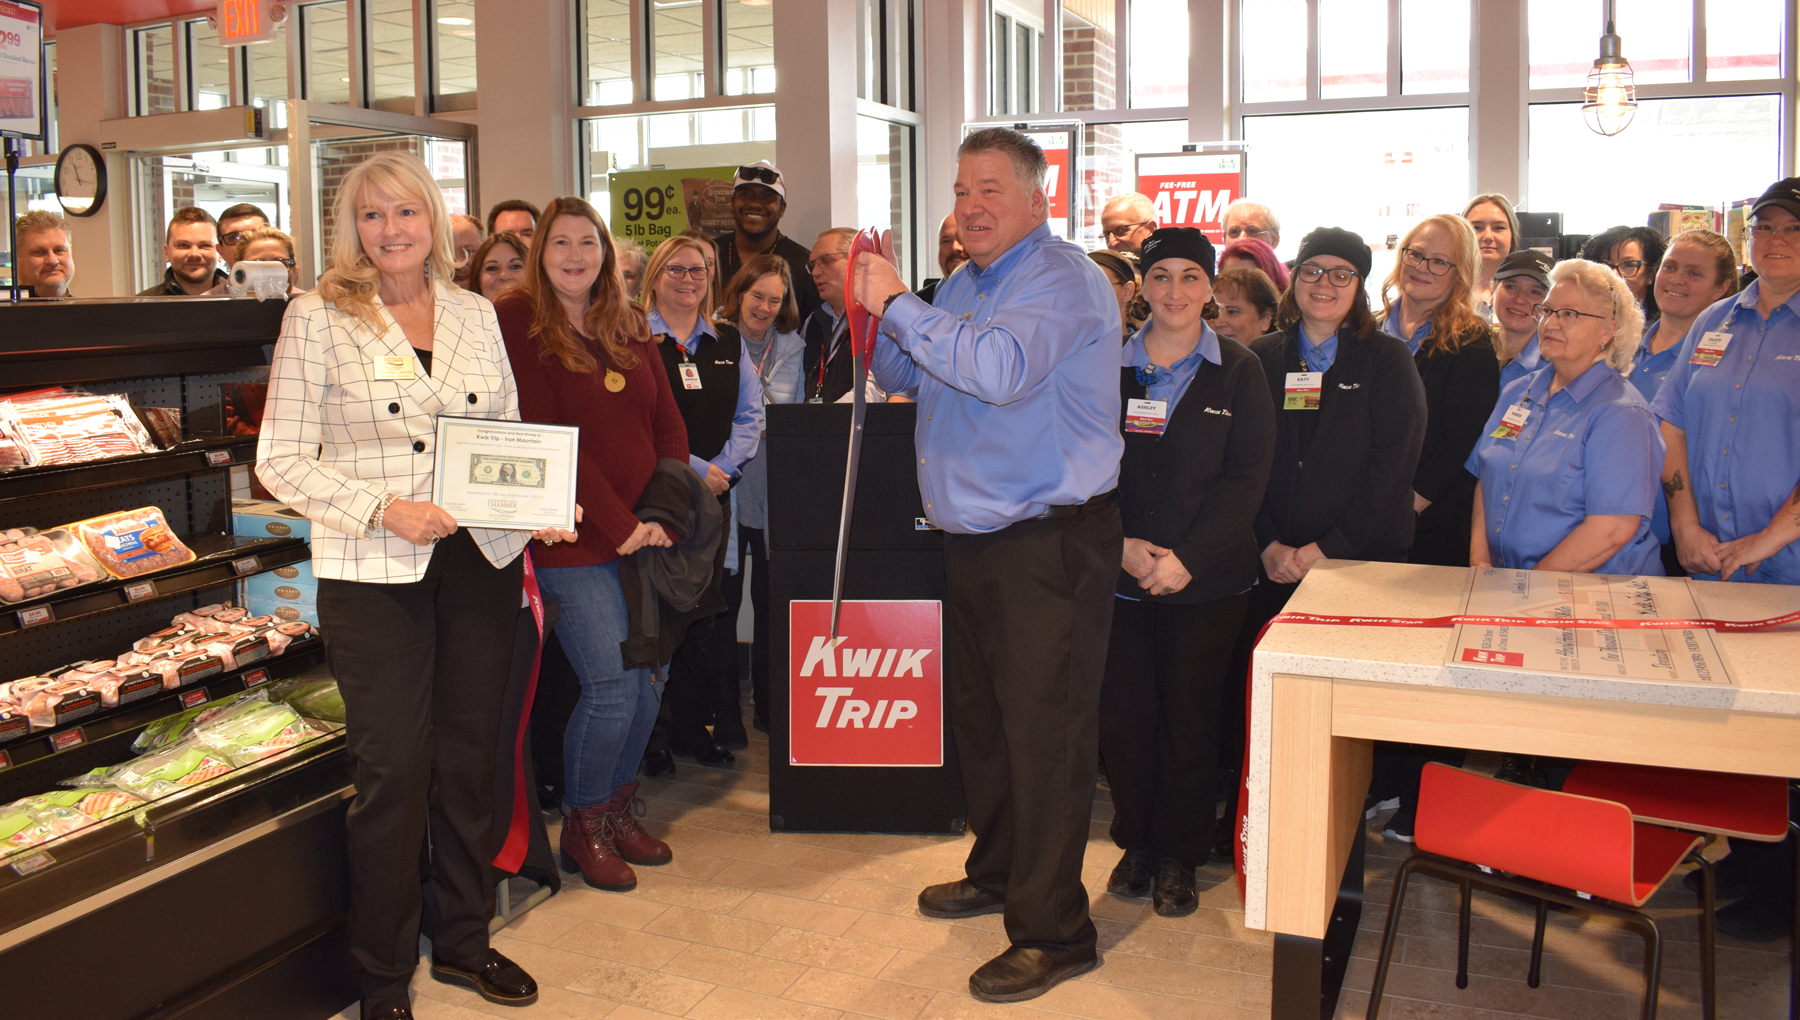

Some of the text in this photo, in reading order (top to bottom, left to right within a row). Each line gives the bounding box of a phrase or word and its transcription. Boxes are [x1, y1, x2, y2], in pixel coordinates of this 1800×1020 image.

[224, 0, 260, 38] EXIT
[1160, 181, 1196, 189] FEE-FREE
[1153, 189, 1231, 224] ATM
[625, 224, 671, 237] 5 lb Bag
[119, 534, 135, 543] ATS
[13, 566, 33, 575] BRAT
[1766, 614, 1799, 624] STAR
[799, 636, 933, 678] KWIK
[1471, 650, 1489, 662] KWIK
[1489, 652, 1506, 662] TRIP
[1647, 648, 1672, 669] Donation
[815, 687, 918, 729] TRIP
